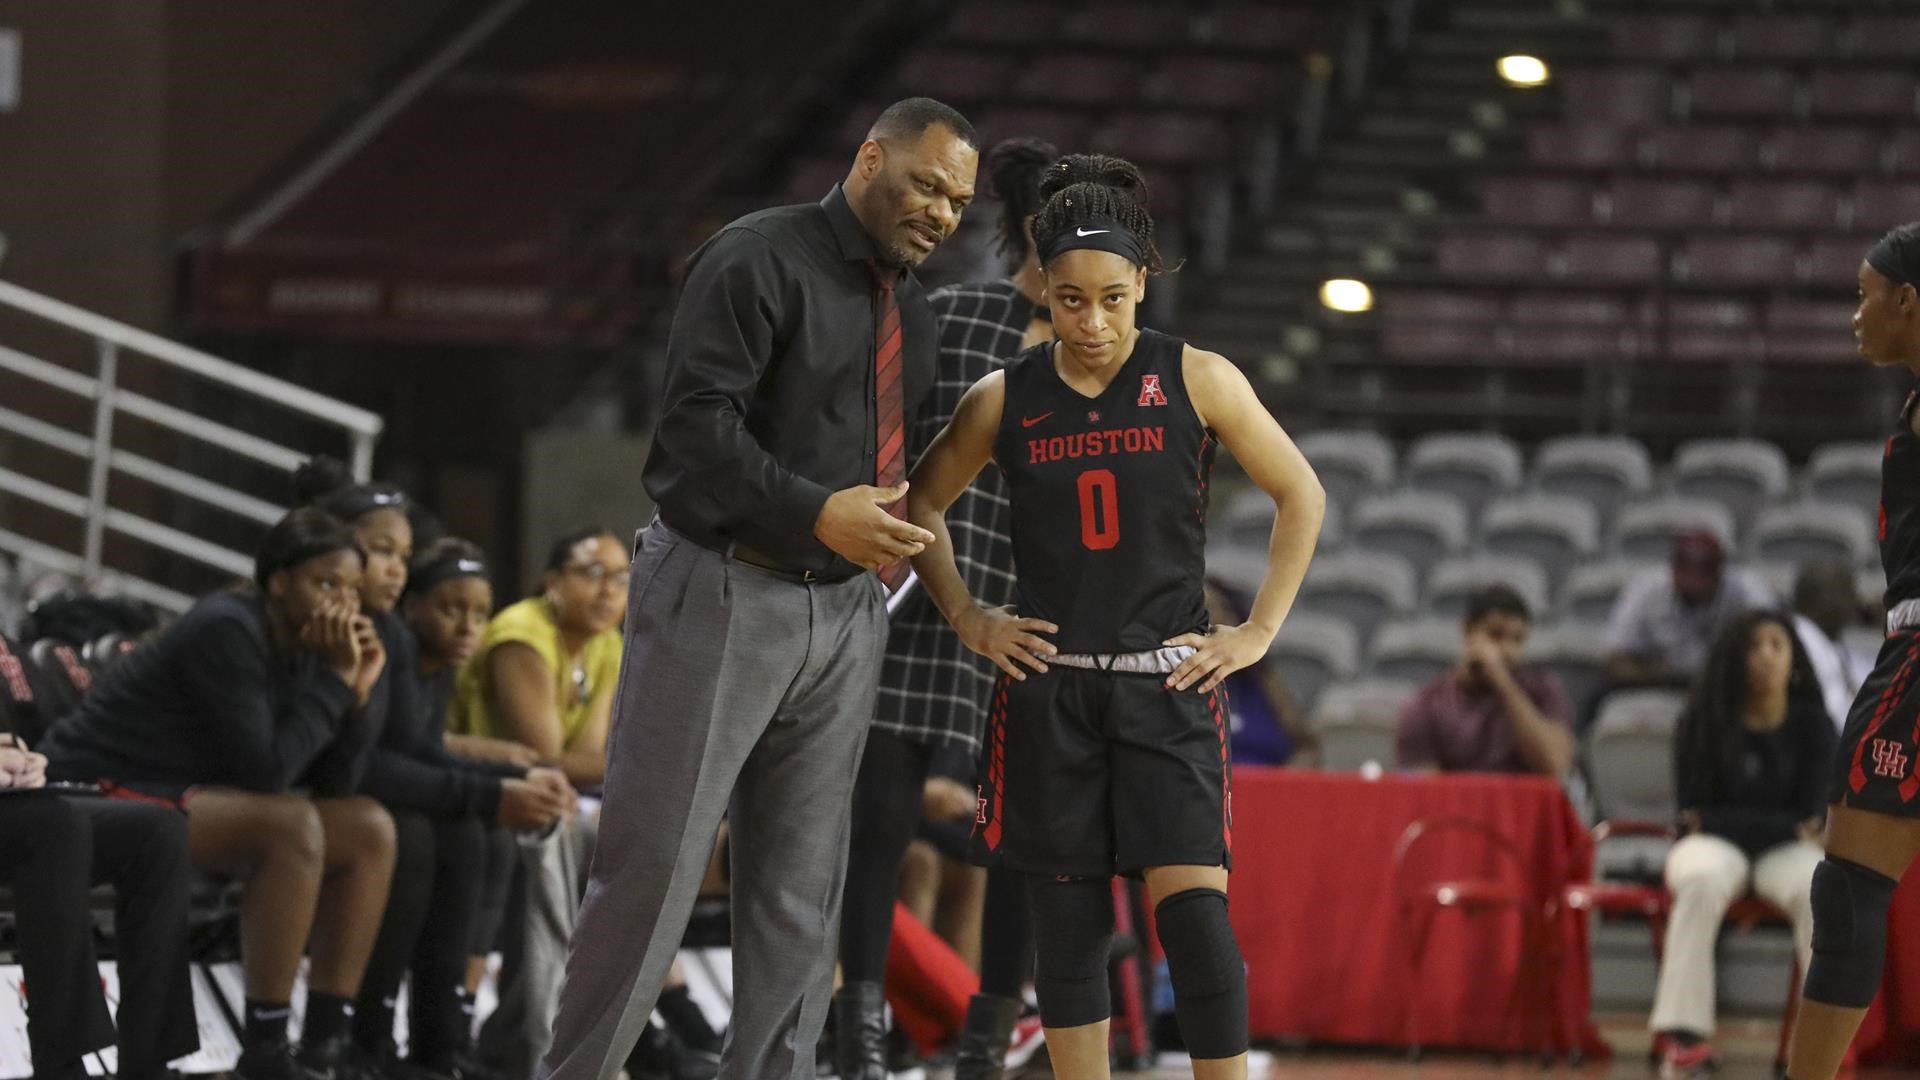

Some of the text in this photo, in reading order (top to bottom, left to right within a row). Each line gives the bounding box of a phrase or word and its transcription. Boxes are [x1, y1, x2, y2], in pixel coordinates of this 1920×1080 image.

[1138, 374, 1168, 406] A
[1029, 427, 1165, 464] HOUSTON
[1077, 469, 1120, 550] 0
